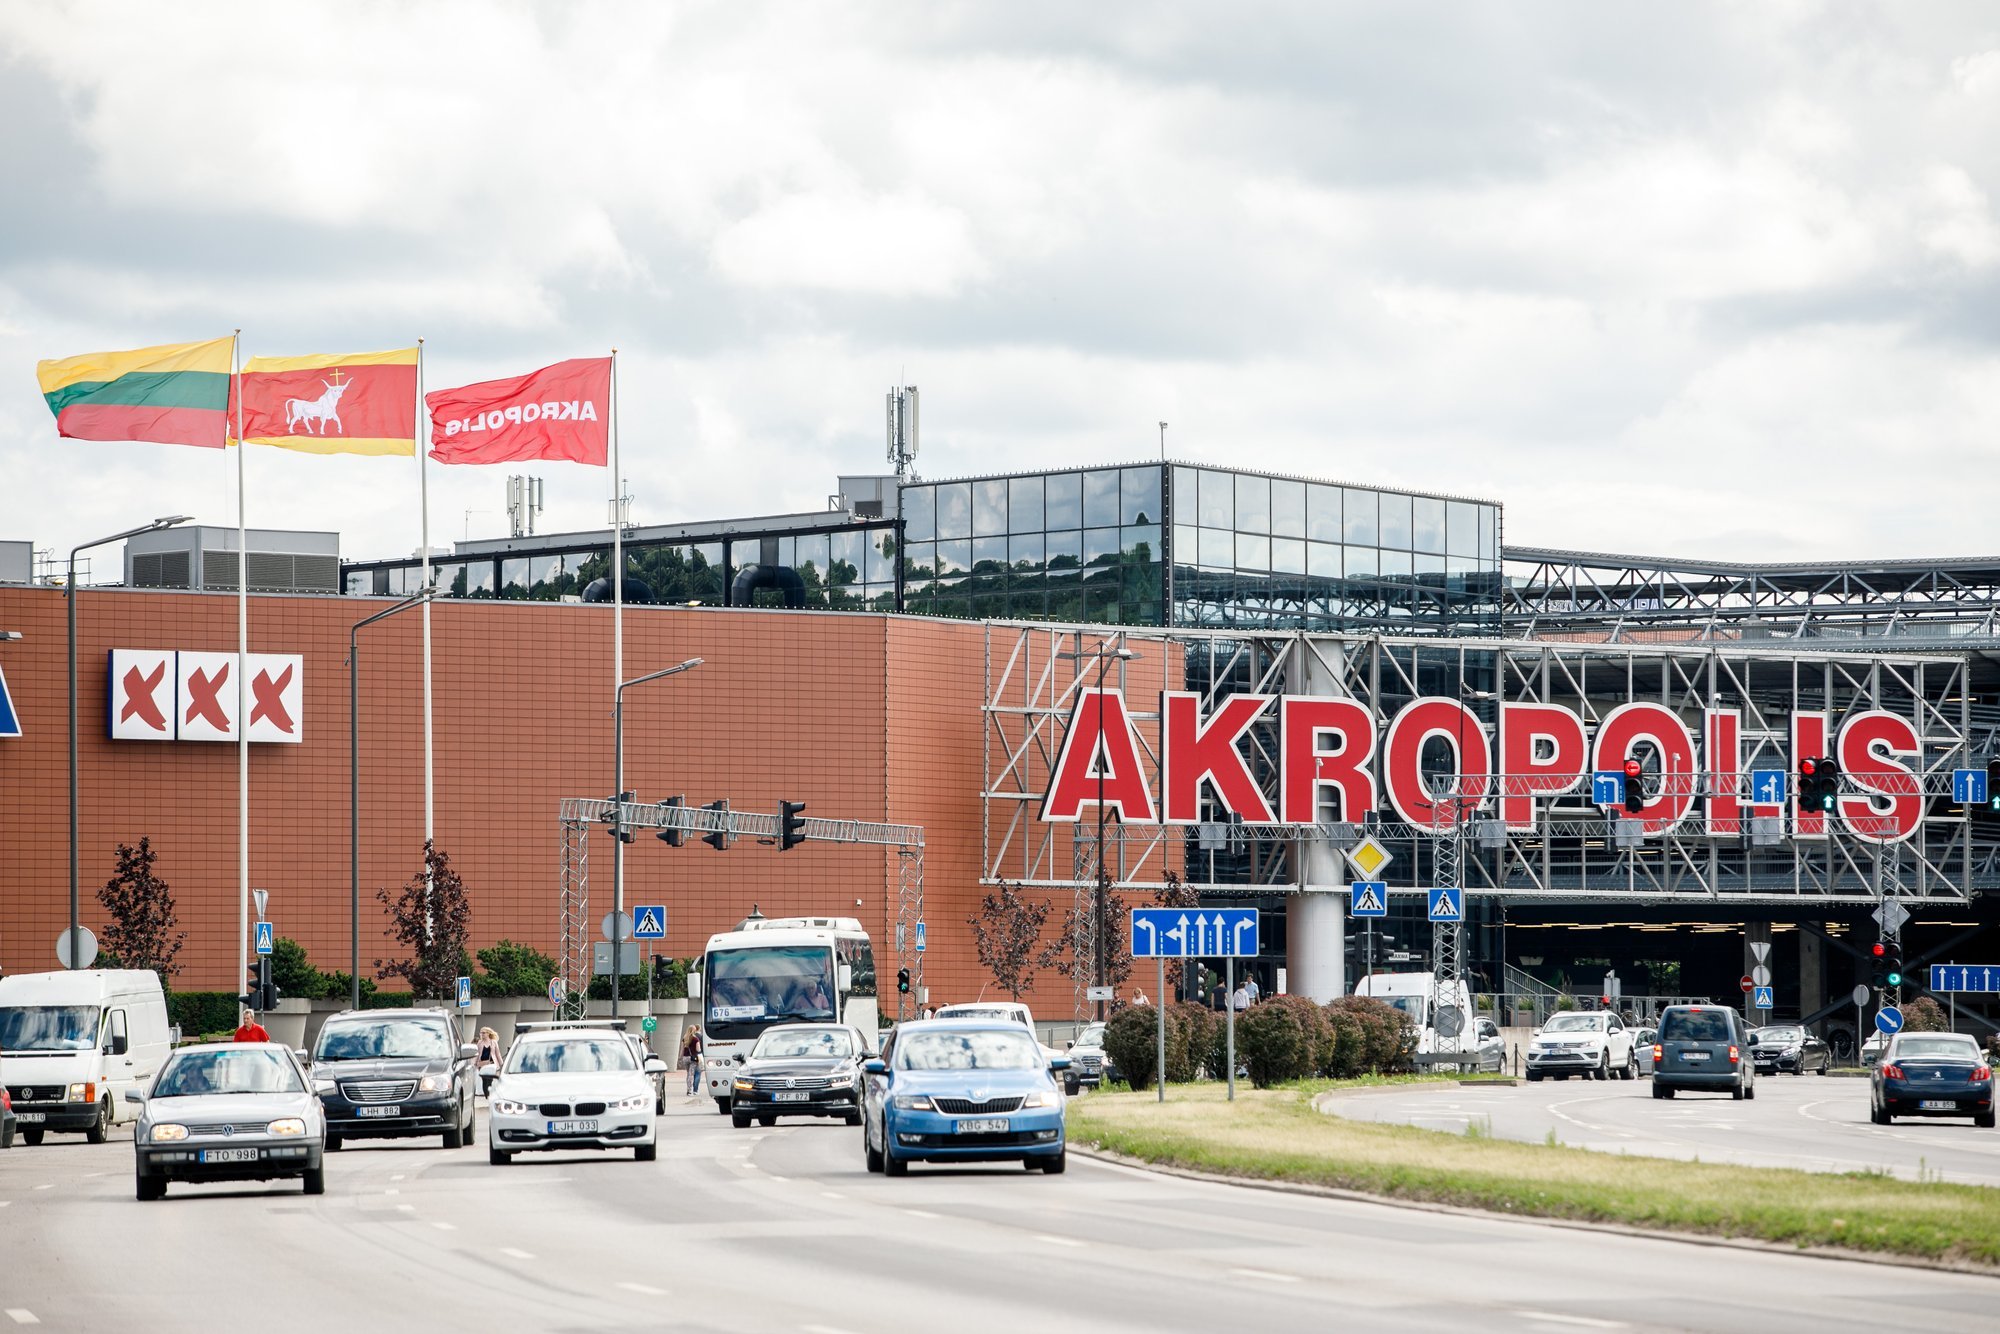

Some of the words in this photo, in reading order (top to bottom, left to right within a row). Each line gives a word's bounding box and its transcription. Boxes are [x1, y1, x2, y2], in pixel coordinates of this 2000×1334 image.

[1039, 686, 1926, 844] AKROPOLIS
[713, 1008, 730, 1018] 676
[361, 1107, 379, 1116] LHH
[553, 1122, 574, 1131] LJH
[579, 1121, 596, 1130] 033
[958, 1121, 981, 1130] KBG
[988, 1120, 1007, 1130] 547
[206, 1151, 230, 1161] FTO
[236, 1149, 257, 1160] 998
